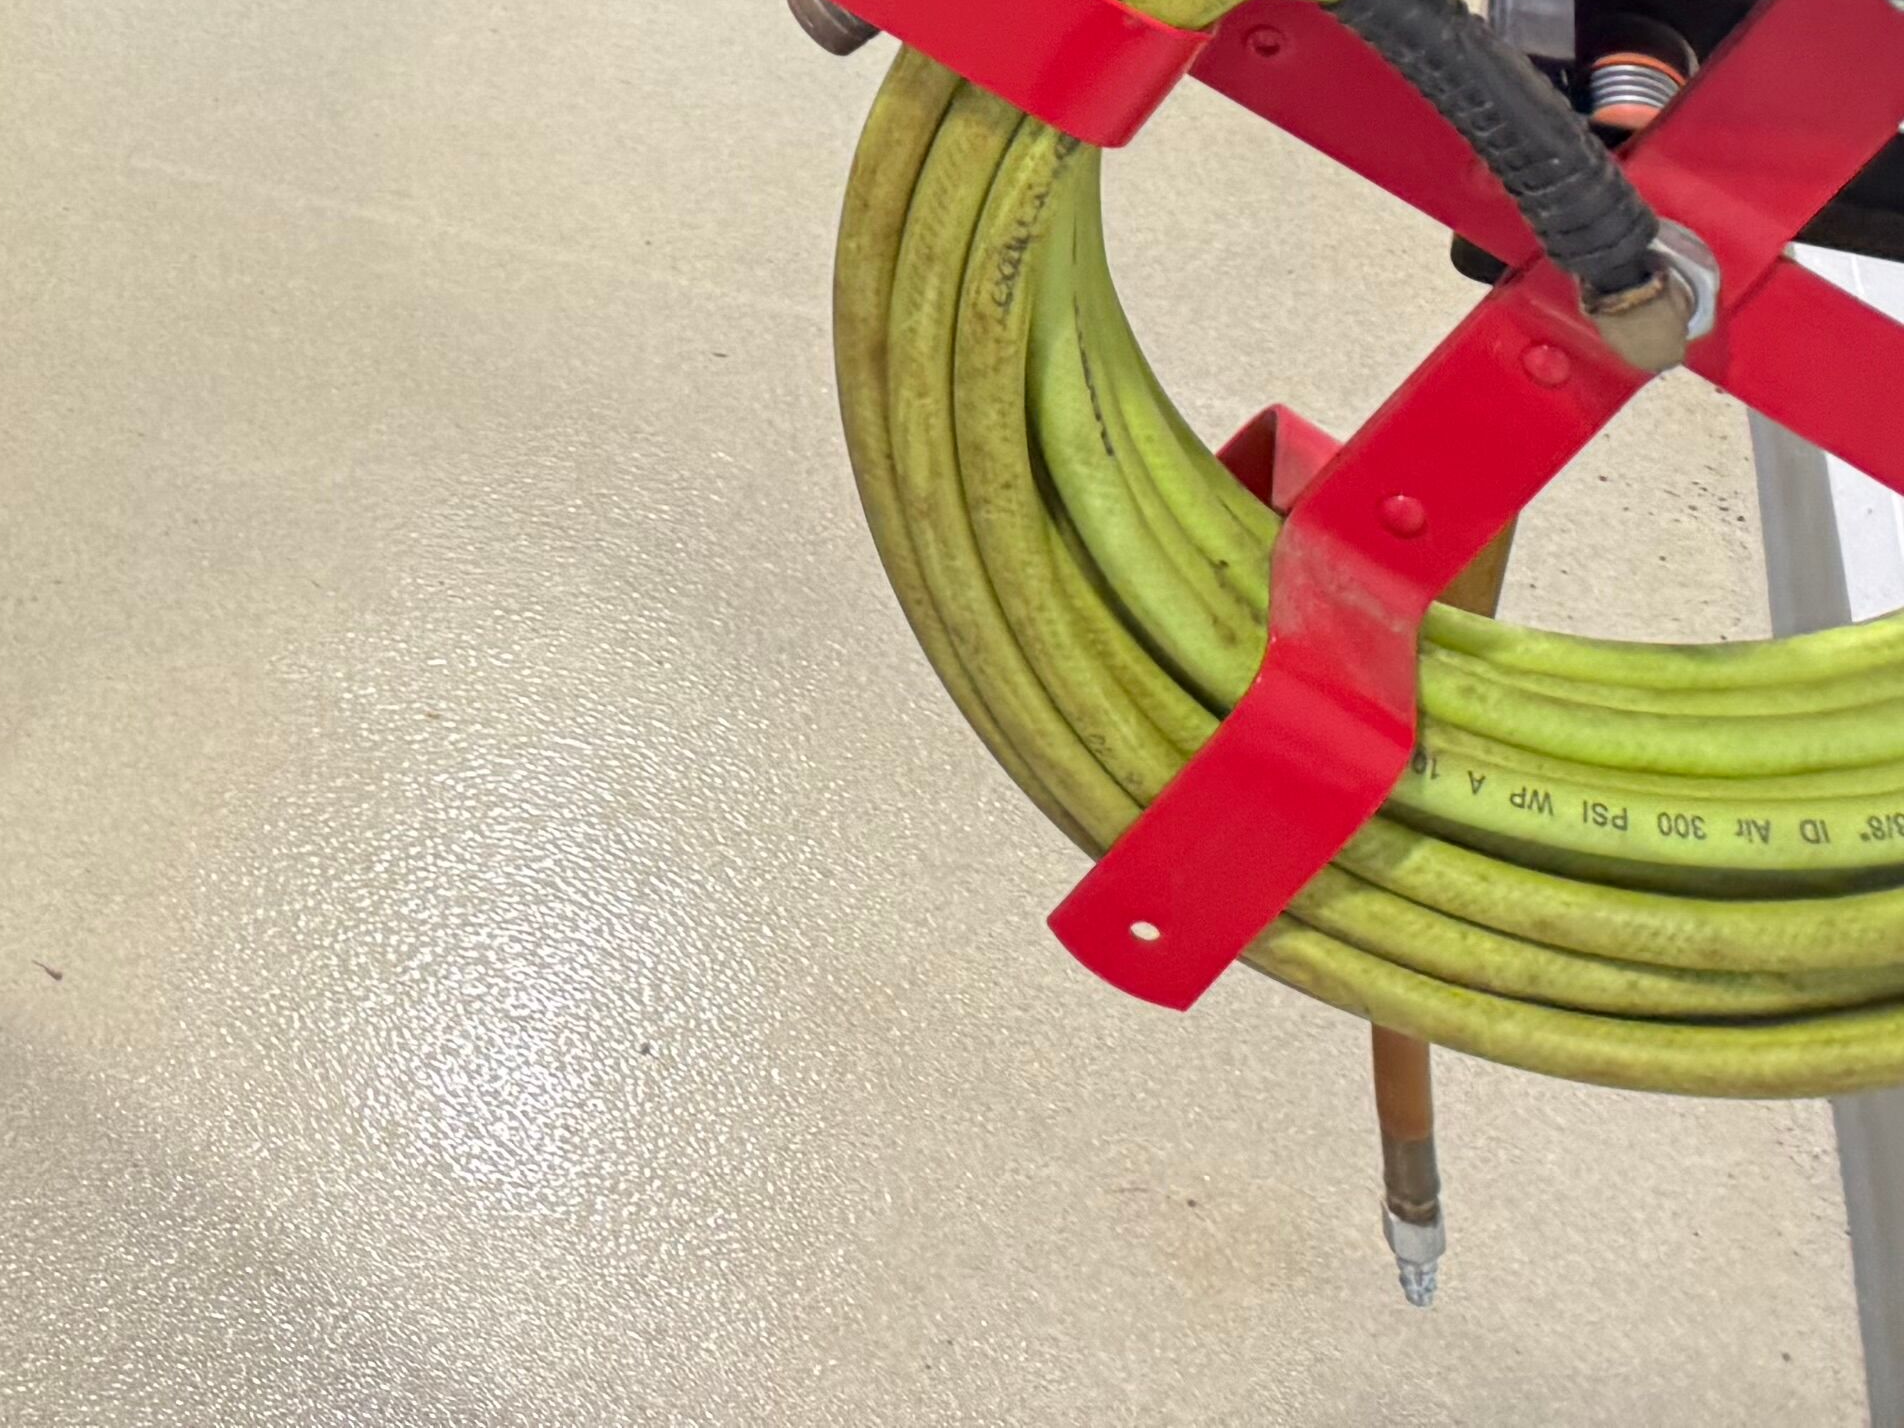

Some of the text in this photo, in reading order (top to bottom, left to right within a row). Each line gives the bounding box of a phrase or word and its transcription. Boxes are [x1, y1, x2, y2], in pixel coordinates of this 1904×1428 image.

[1467, 771, 1486, 795] A
[1509, 787, 1554, 816] WP
[1582, 800, 1629, 831] PSI
[1657, 811, 1706, 840] 300
[1734, 816, 1771, 844] Air
[1801, 818, 1829, 844] ID
